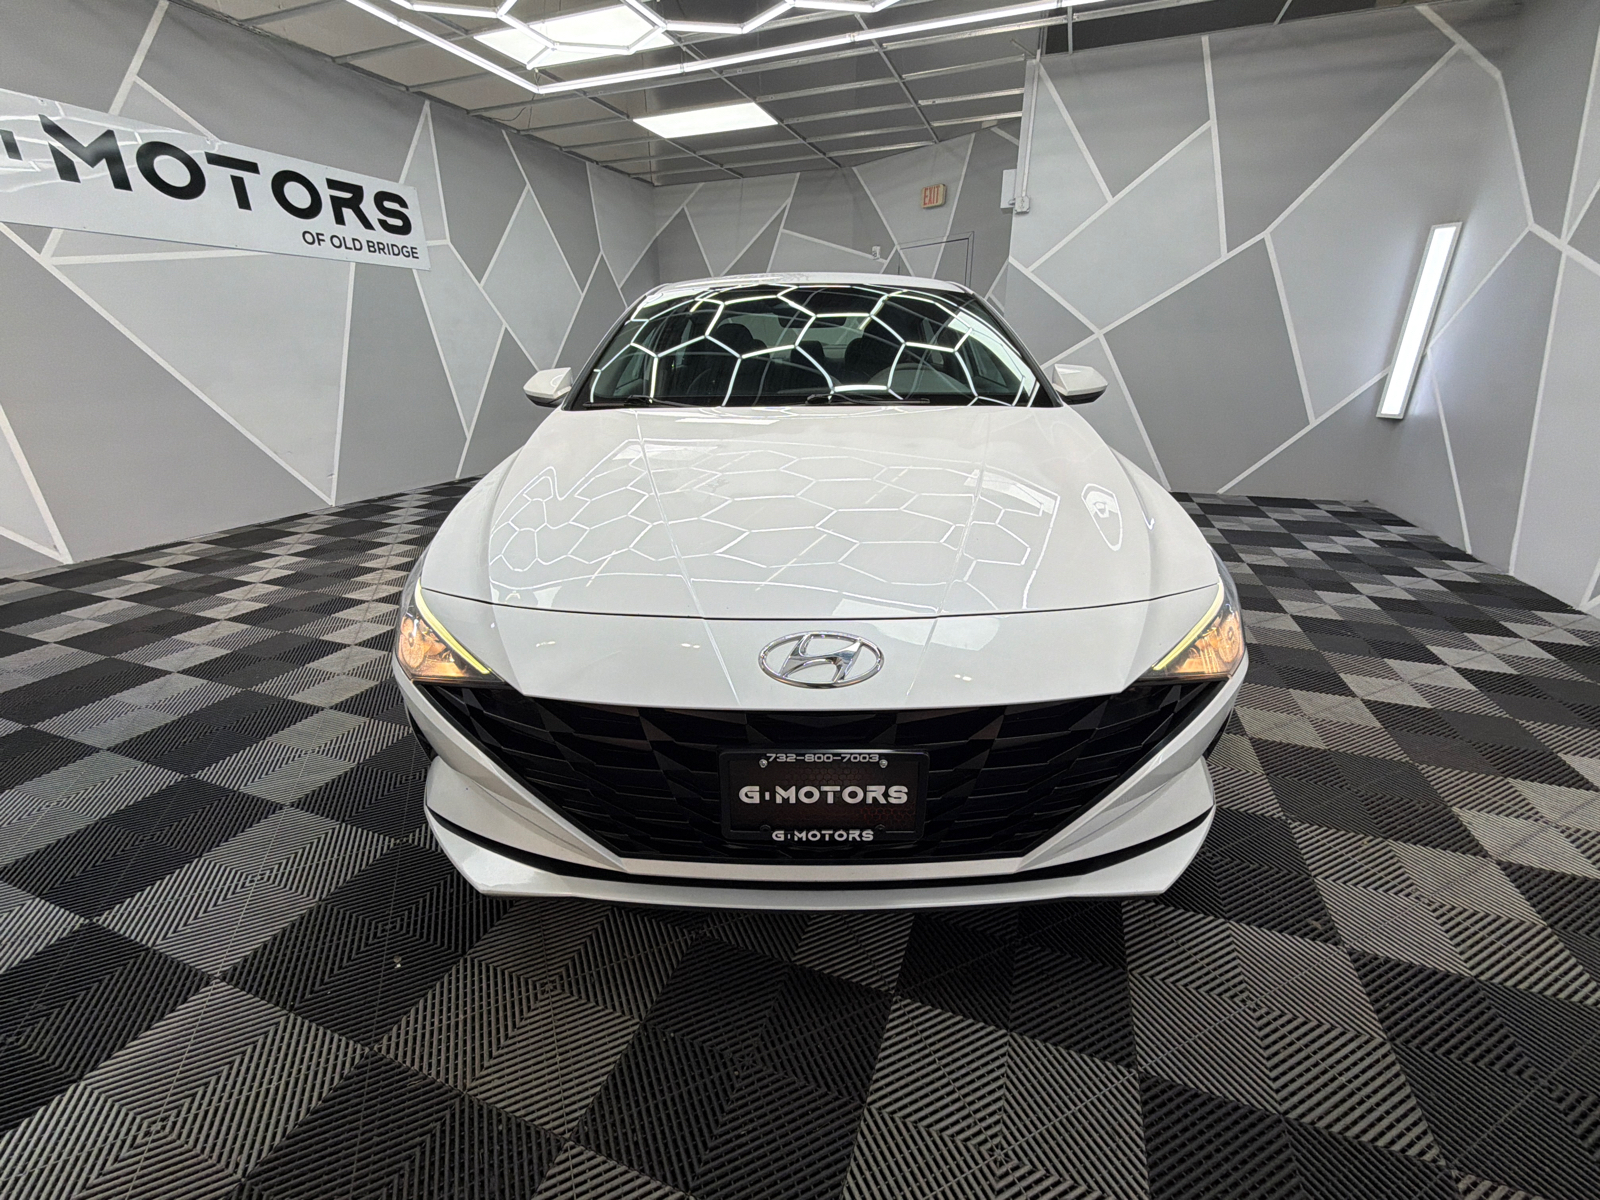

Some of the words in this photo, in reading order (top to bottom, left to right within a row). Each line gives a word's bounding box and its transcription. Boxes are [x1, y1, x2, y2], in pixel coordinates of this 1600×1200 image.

[923, 185, 941, 206] EXIT
[302, 230, 326, 246] OF
[329, 234, 363, 252] OLD
[366, 239, 420, 259] BRIDGE
[766, 753, 880, 763] 732-800-7003
